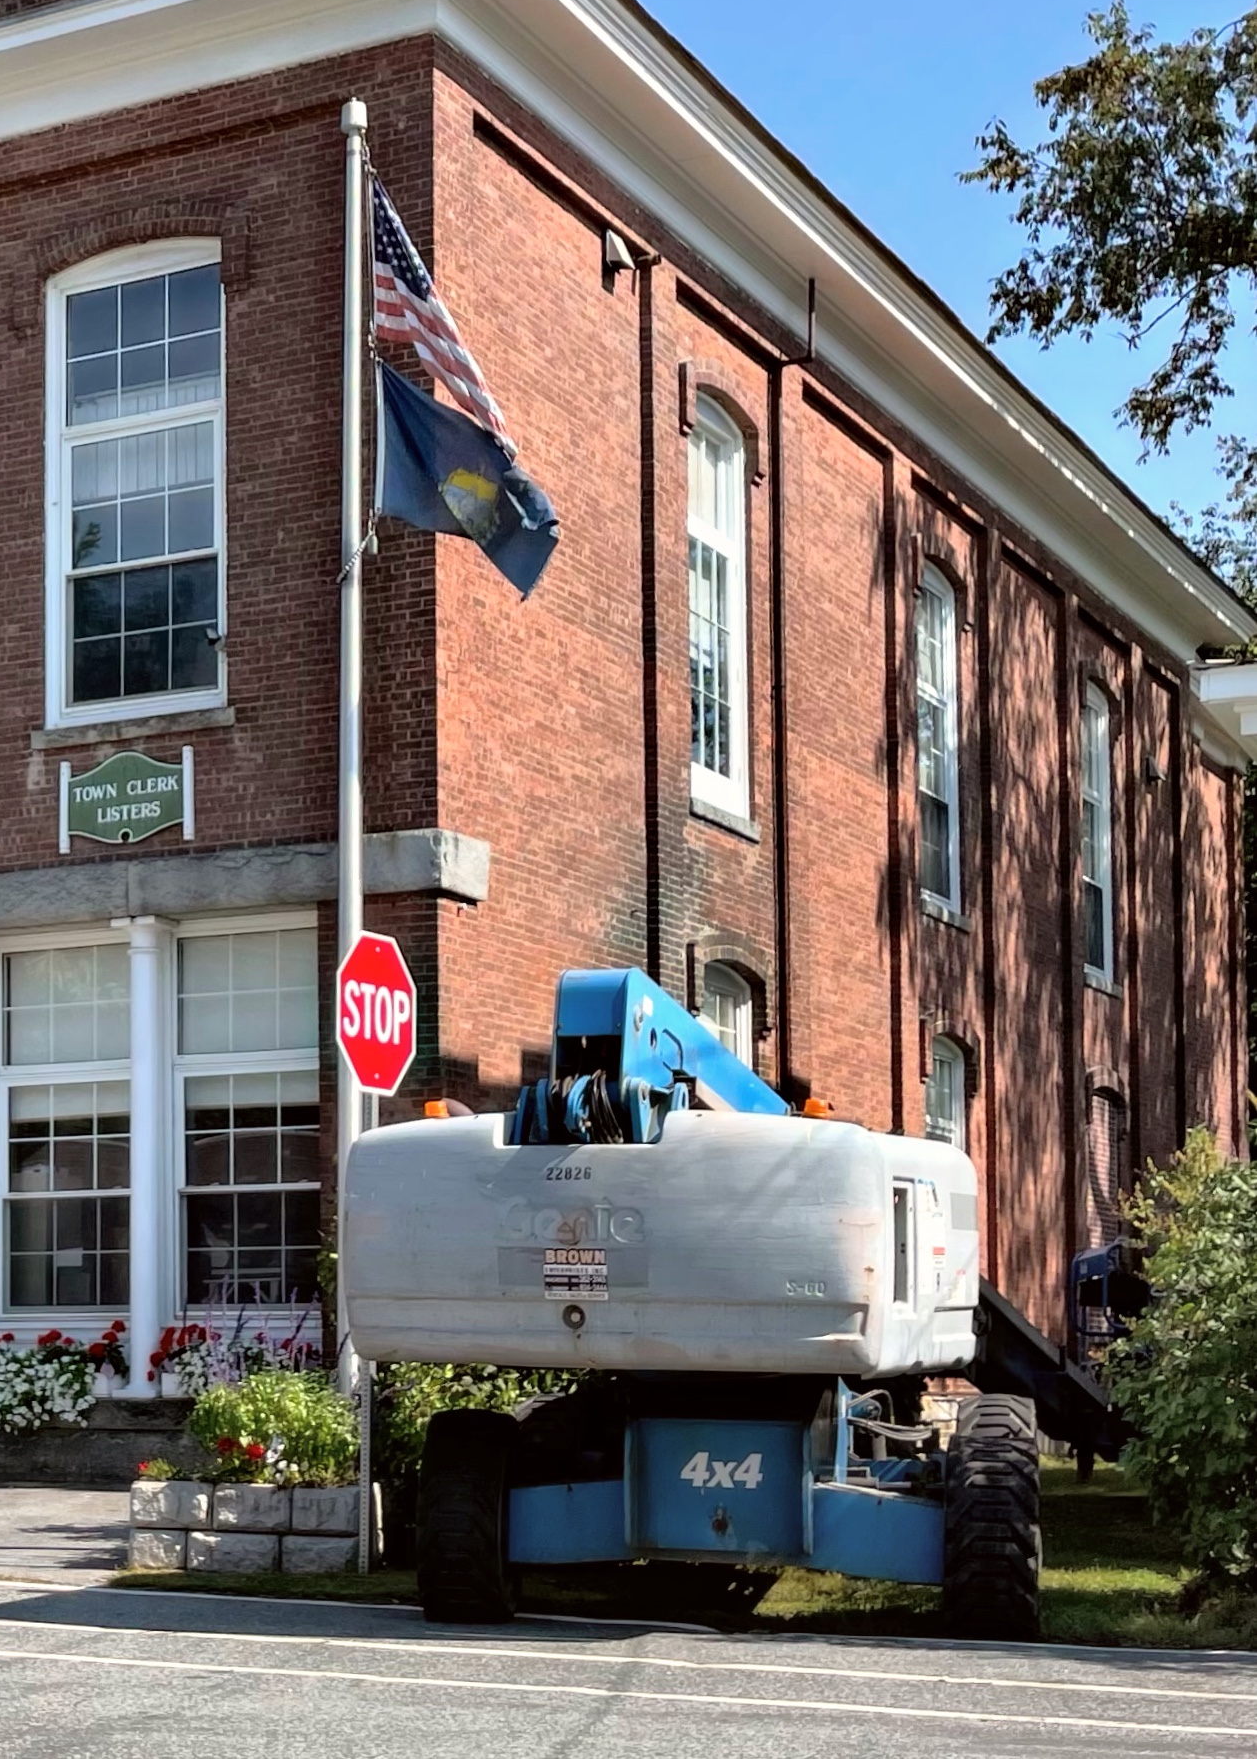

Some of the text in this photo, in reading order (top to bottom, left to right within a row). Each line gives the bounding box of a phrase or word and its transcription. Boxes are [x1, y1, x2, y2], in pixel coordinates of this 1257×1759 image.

[73, 775, 179, 803] TOWN CLERK
[97, 801, 161, 823] LISTERS
[343, 979, 411, 1045] STOP
[545, 1167, 592, 1181] 22826
[545, 1249, 606, 1264] BROWN
[680, 1451, 763, 1489] 4x4
